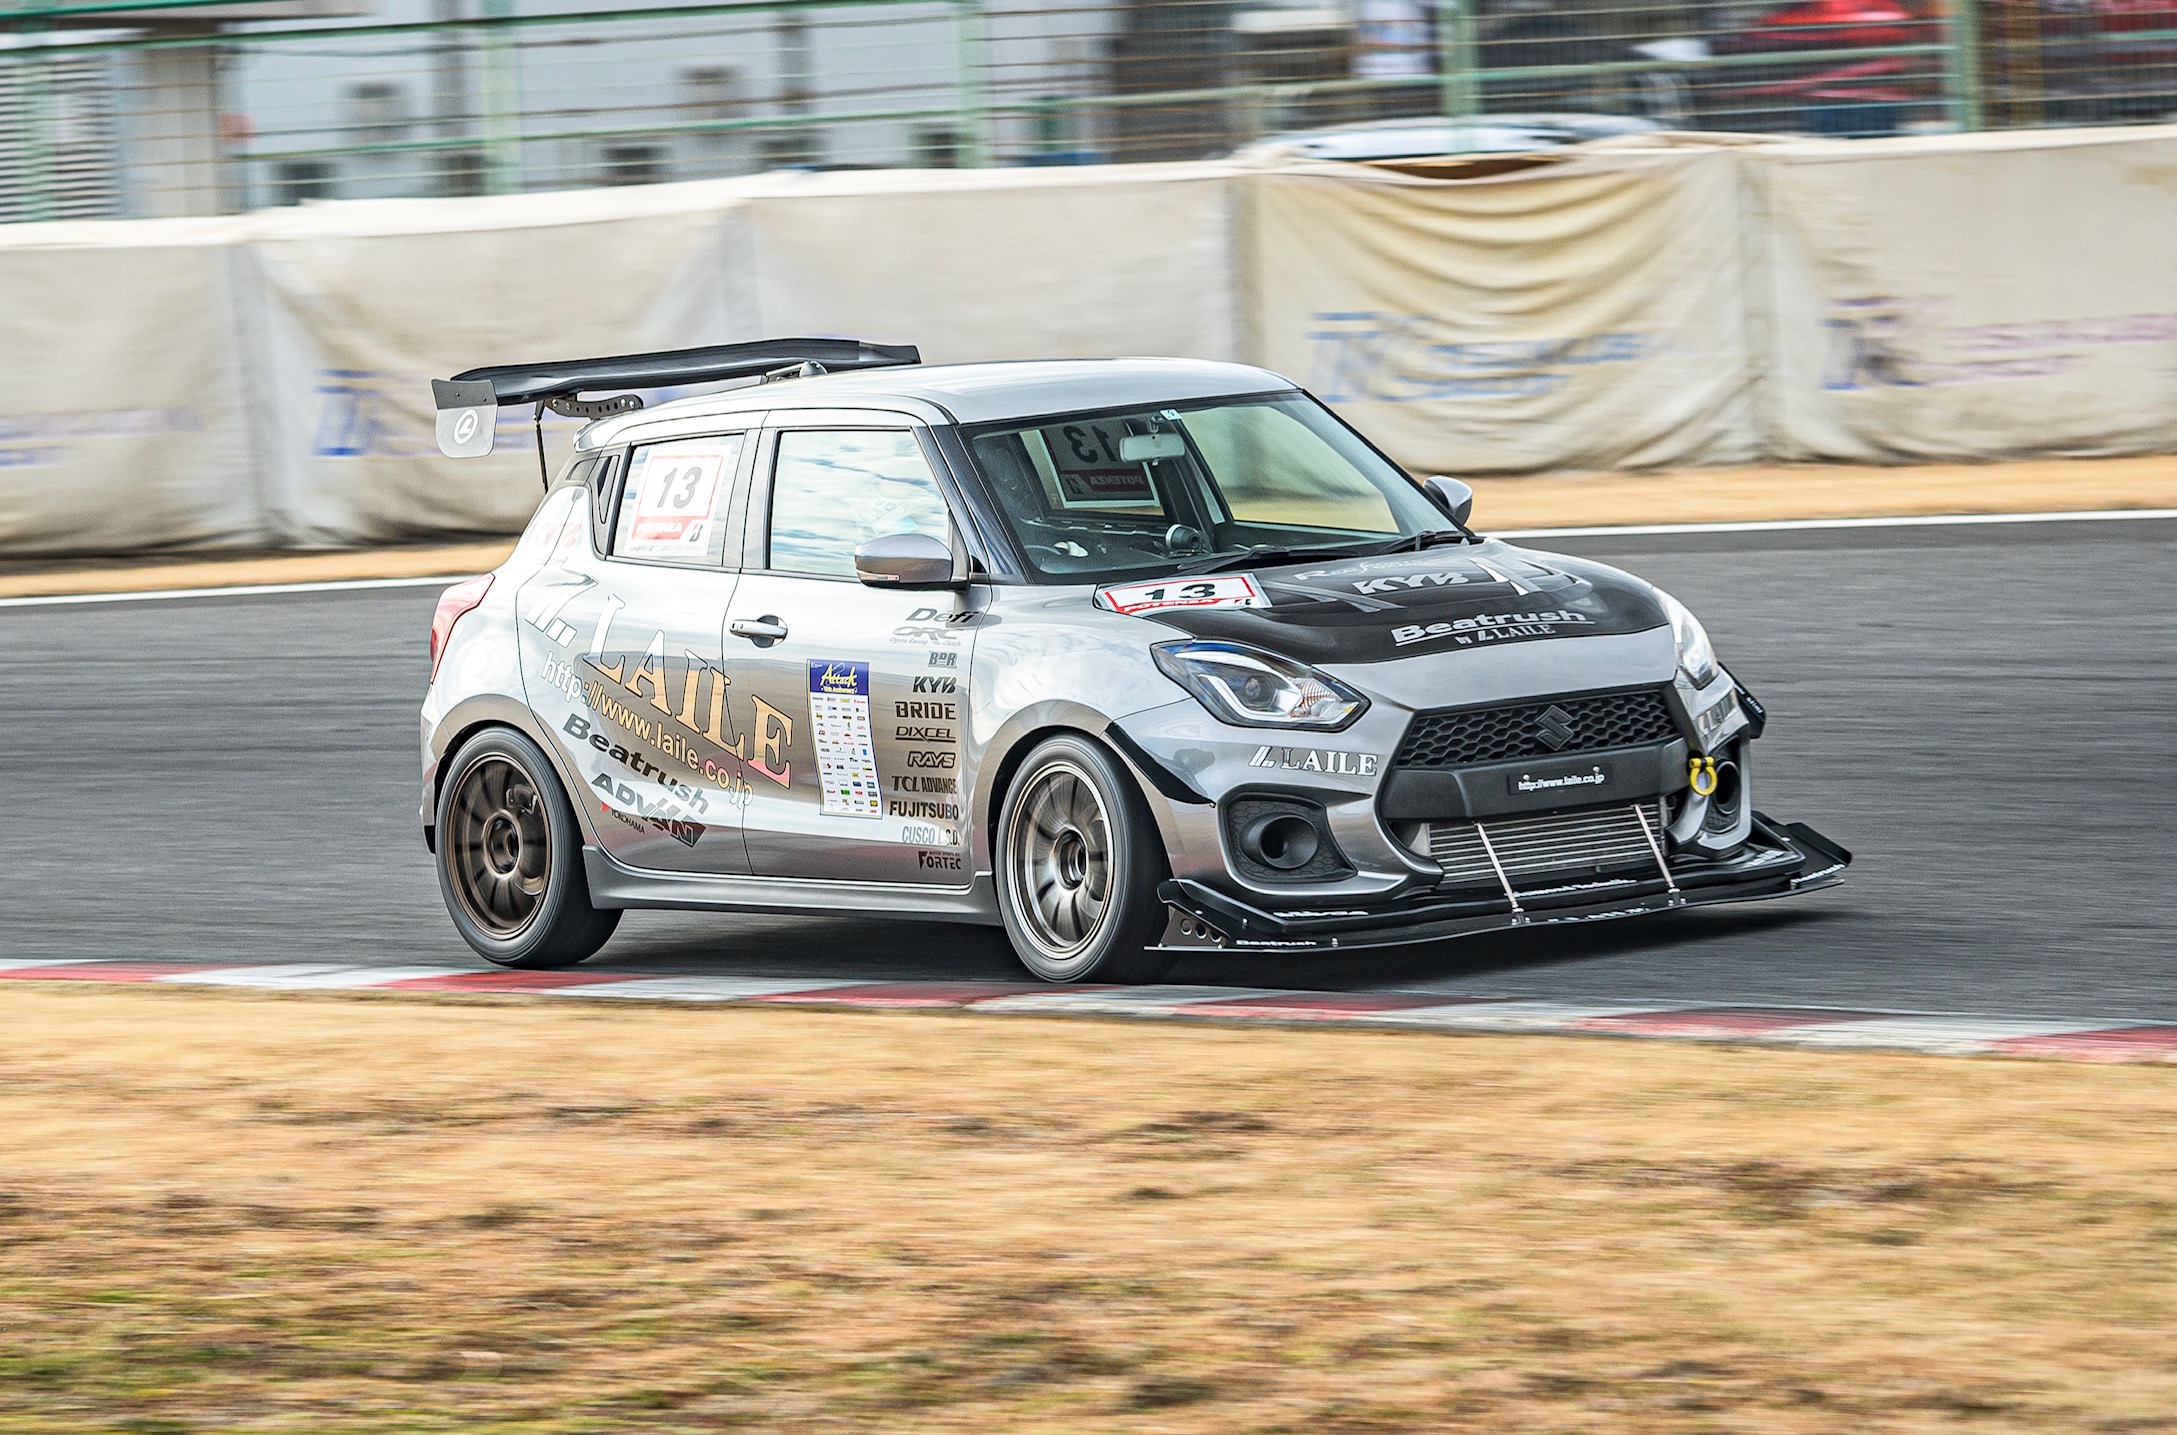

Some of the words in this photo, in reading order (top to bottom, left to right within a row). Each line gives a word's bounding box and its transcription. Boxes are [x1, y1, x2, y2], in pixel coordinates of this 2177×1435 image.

[657, 466, 702, 509] 13
[1145, 583, 1216, 601] 13
[1352, 572, 1469, 595] KYB
[905, 607, 980, 623] Defi
[1391, 609, 1587, 643] Beatrush
[1497, 624, 1556, 639] LAILE
[820, 663, 857, 687] Attack
[582, 593, 793, 790] LAILE
[912, 676, 957, 694] KYB
[894, 701, 957, 720] BRIDE
[541, 651, 754, 809] http://www.laile.co.jp
[895, 726, 957, 743] DIXCEL
[562, 713, 709, 815] Beatrush
[907, 751, 956, 769] RAYS
[1280, 747, 1378, 776] LAILE
[892, 776, 920, 792] TCL
[921, 777, 958, 794] ADVANCE
[591, 773, 707, 848] ADVAN
[889, 801, 959, 820] FUJITSUBO
[611, 808, 646, 836] YOKOHAMA
[902, 826, 936, 844] CUSCO
[918, 851, 962, 870] FORTEC
